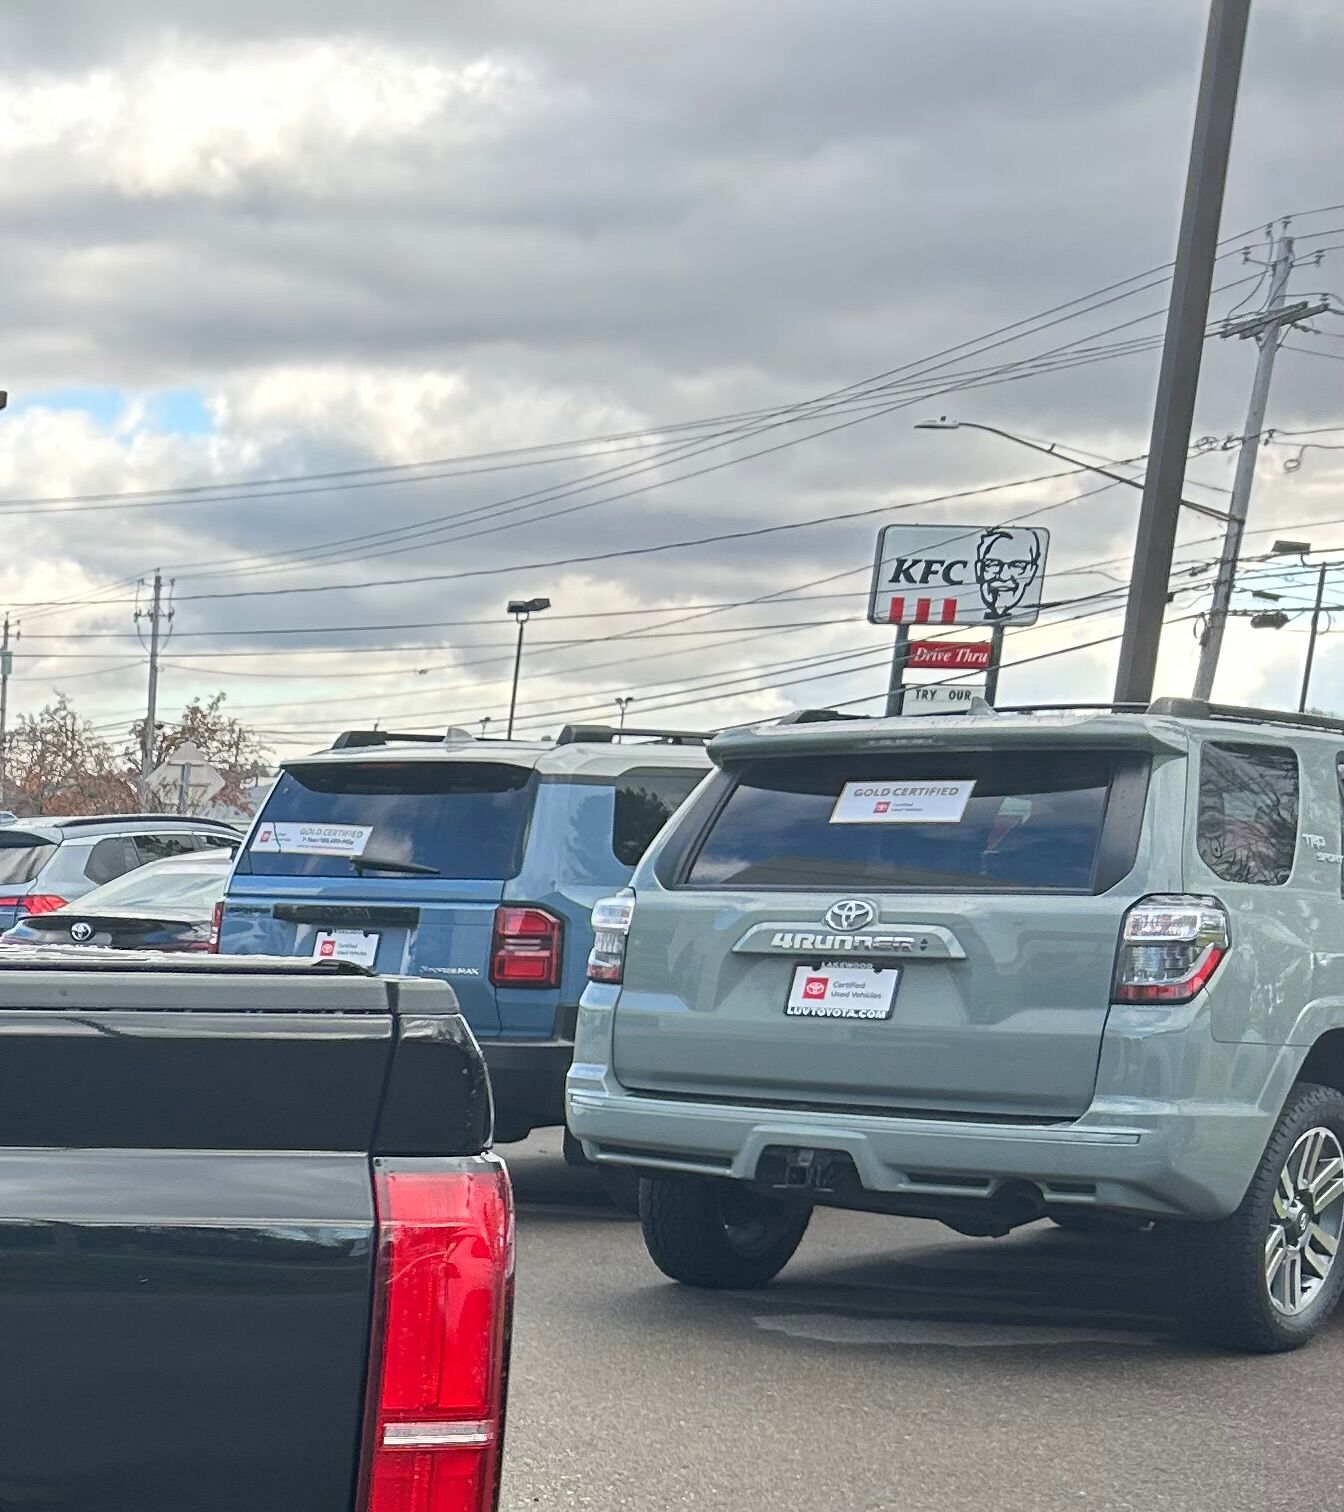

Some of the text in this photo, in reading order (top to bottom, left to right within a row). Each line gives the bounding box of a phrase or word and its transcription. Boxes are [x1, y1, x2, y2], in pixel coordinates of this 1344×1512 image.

[888, 558, 968, 586] KFC
[914, 647, 989, 663] Drive Thru
[915, 689, 972, 701] TRY OUR
[854, 787, 960, 797] GOLD CERTIFIED
[300, 827, 364, 839] GOLD CERTIFIED
[770, 932, 915, 953] 4RUNNER
[820, 961, 874, 969] LAKEWOOD
[832, 980, 866, 989] Certified
[830, 990, 882, 1000] Used Vehicles
[786, 1006, 887, 1020] LUVTOYOTA.COM
